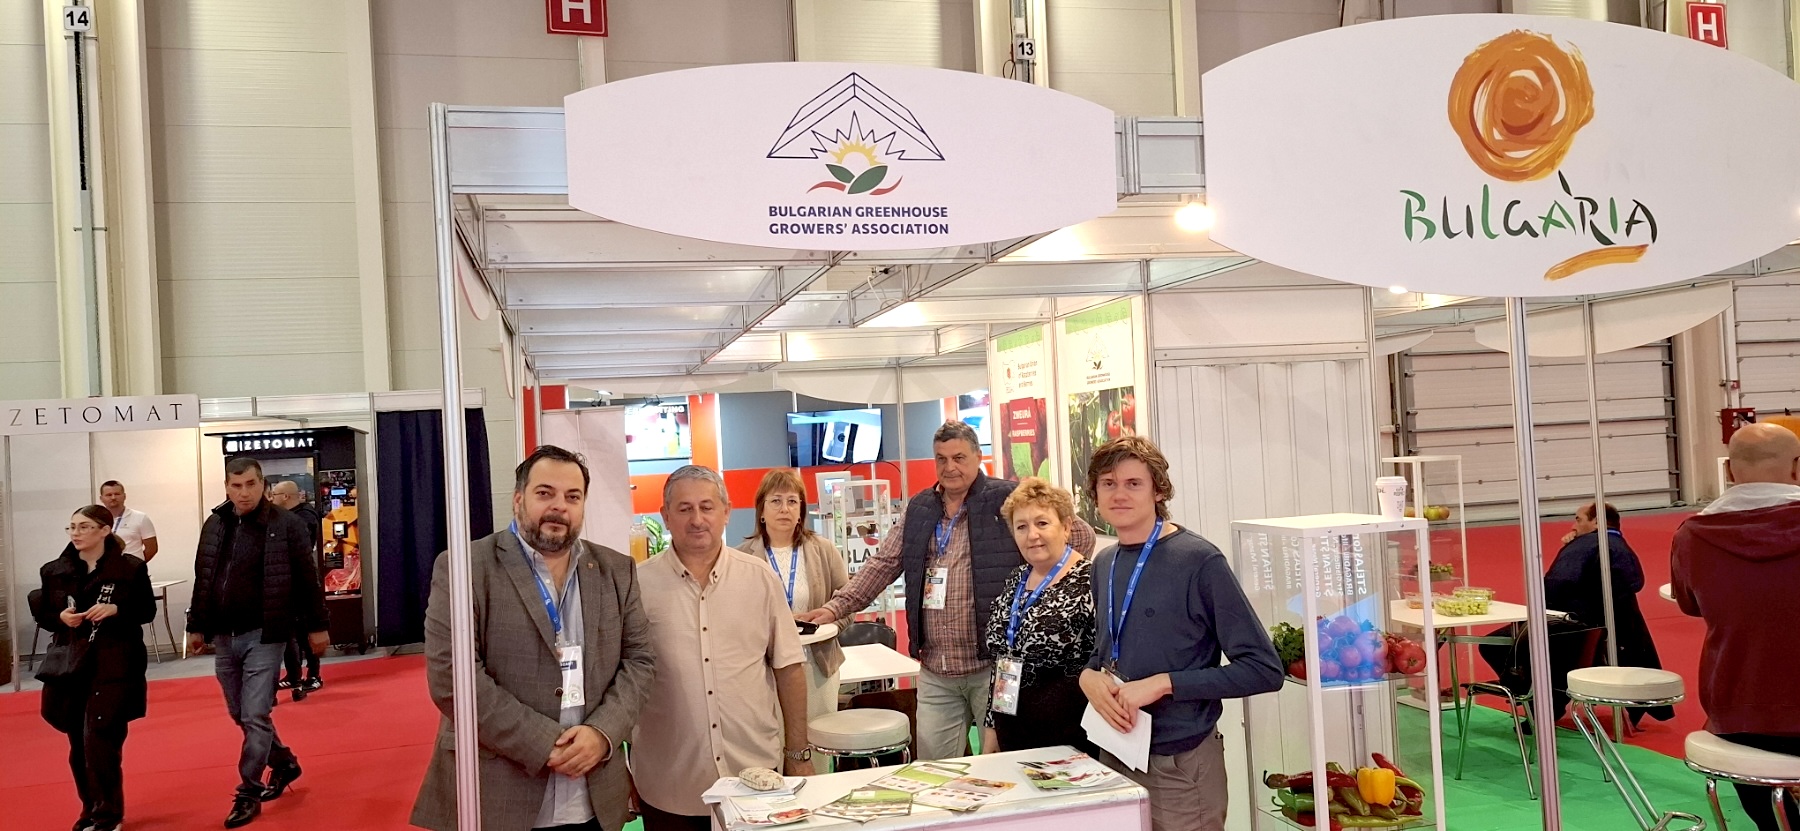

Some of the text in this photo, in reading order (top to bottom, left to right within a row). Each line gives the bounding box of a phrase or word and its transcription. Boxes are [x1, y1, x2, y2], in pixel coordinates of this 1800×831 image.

[66, 10, 89, 27] 14
[562, 0, 592, 24] H
[1697, 11, 1719, 41] H
[1018, 41, 1034, 56] 13
[768, 206, 948, 218] BULGARIAN GREENHOUSE
[1400, 183, 1658, 246] BULGARIA
[851, 223, 949, 235] ASSOCIATION
[9, 403, 183, 427] ZETOMAT
[244, 437, 314, 451] ZETOMAT
